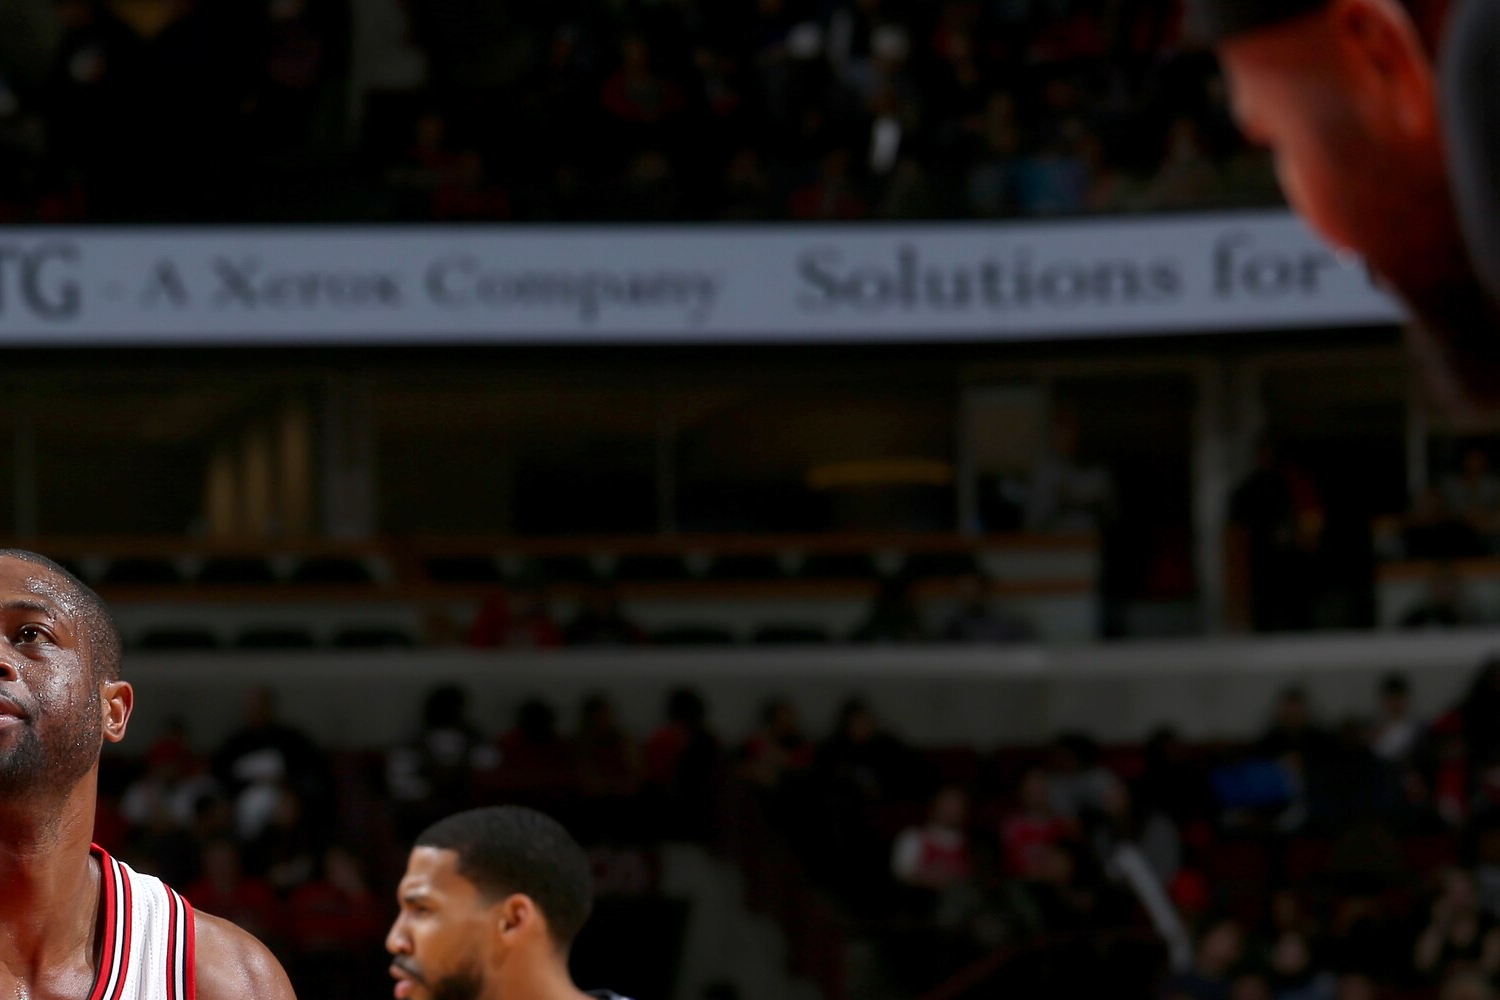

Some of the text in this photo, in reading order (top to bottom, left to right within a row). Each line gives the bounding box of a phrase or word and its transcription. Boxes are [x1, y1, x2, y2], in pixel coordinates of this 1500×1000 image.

[138, 258, 190, 308] A
[207, 257, 398, 309] Xerox
[421, 256, 717, 324] Company
[793, 244, 1176, 313] Solutions
[1203, 232, 1338, 302] for
